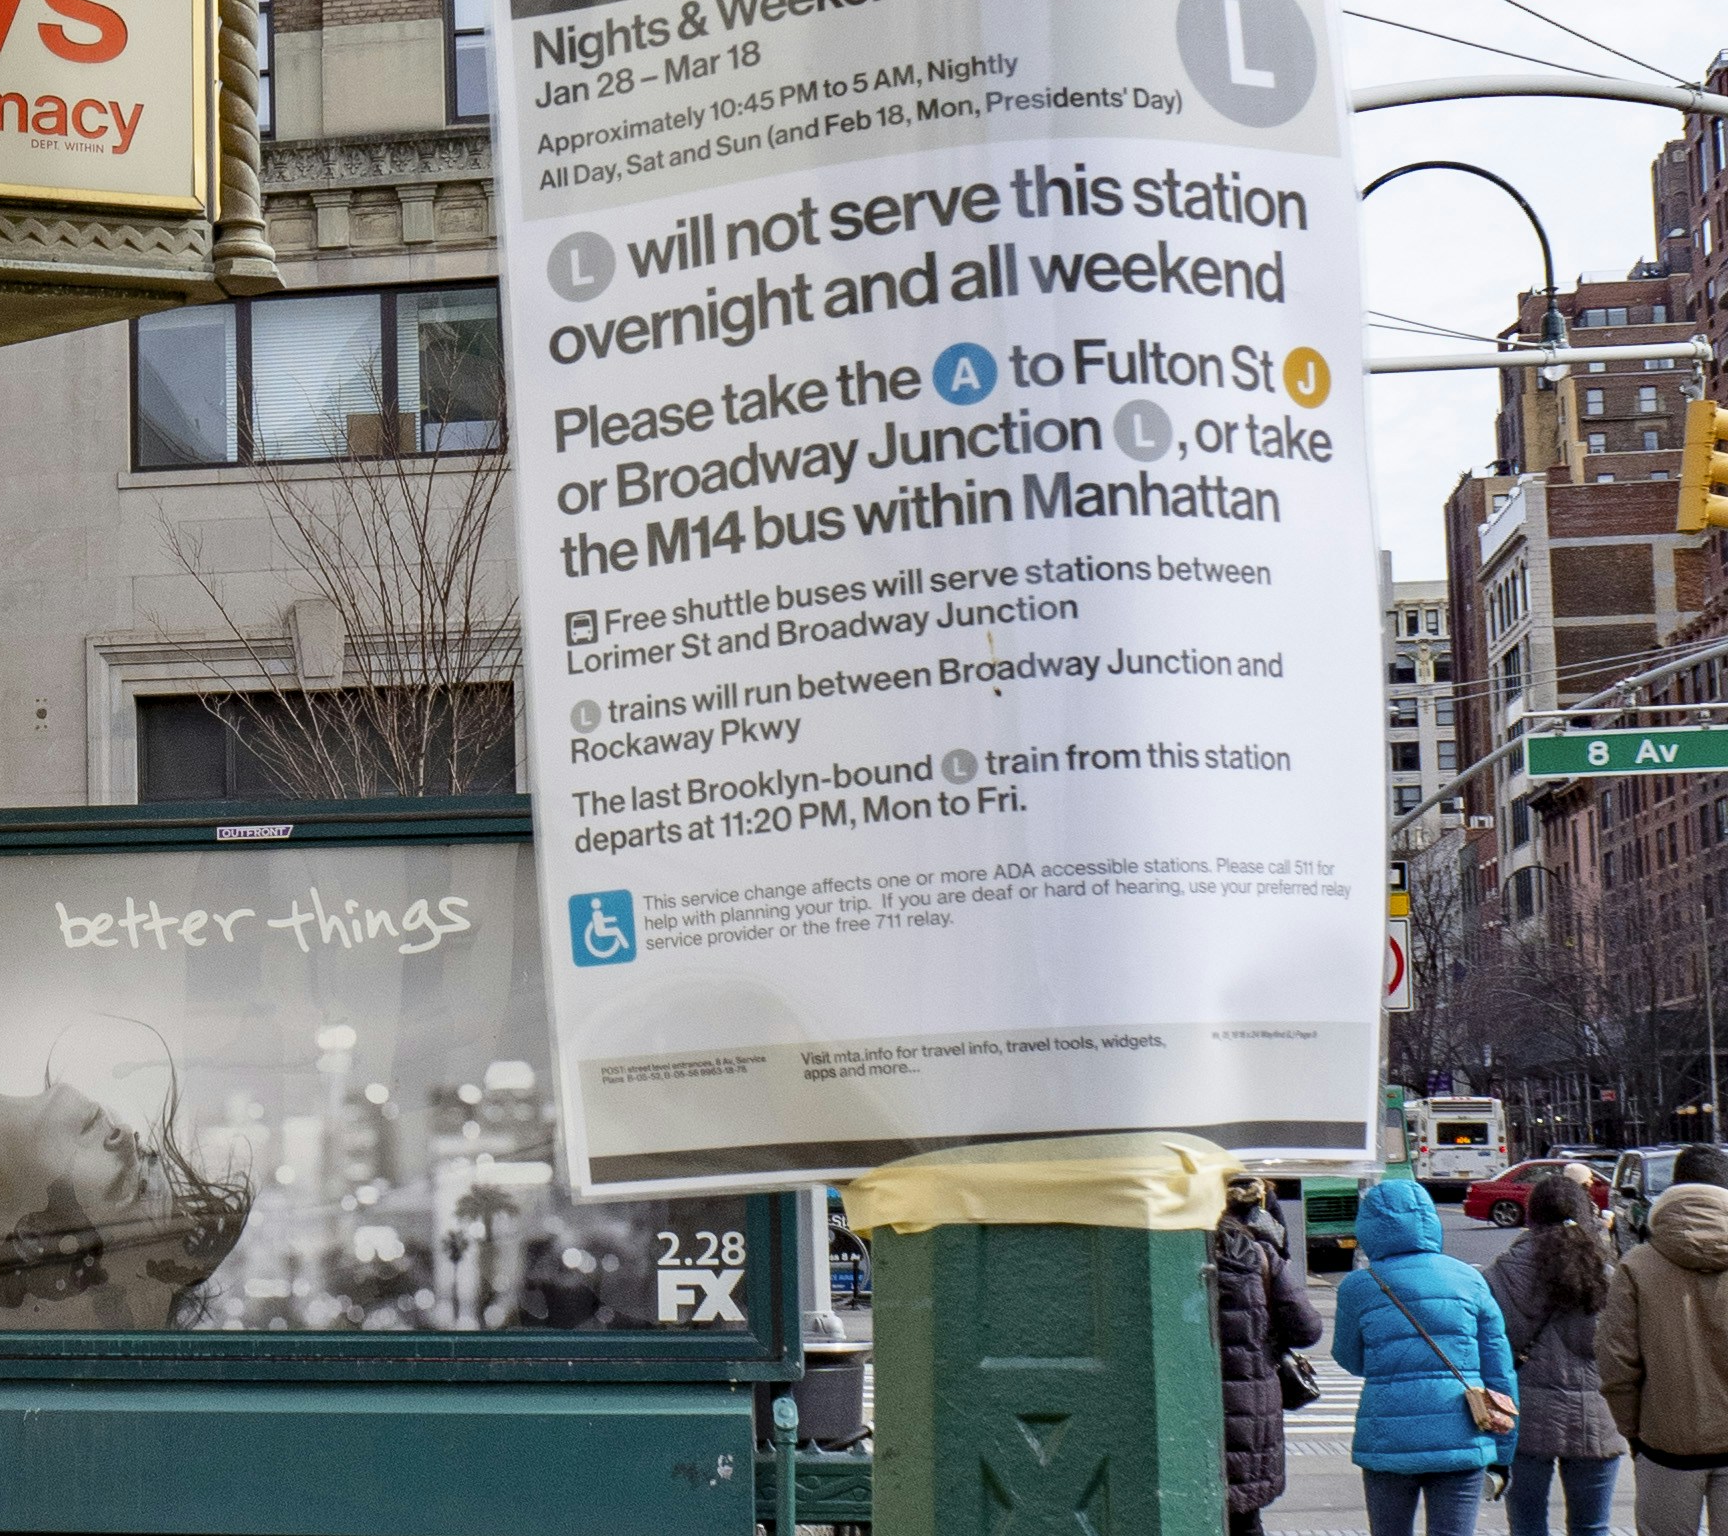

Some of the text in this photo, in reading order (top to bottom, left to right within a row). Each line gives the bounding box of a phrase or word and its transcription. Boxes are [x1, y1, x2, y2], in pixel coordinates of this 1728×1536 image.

[533, 14, 671, 70] Nights
[677, 0, 709, 41] &
[535, 40, 761, 109] Jan 28 Mar 18
[537, 53, 1018, 156] Approximately 10:45 PM to 5 AM, Nightly
[64, 141, 104, 154] WITHIN
[539, 86, 1183, 190] All Day, Sat and Sun (and Feb 18, Mon, Presidents' Day)
[569, 162, 1308, 287] L will not serve this station
[549, 240, 1285, 365] overnight and all weekend
[554, 338, 1317, 453] Please take the A to Fulton St J
[557, 478, 608, 515] or
[616, 438, 859, 508] Broadway
[867, 408, 1103, 469] Junction
[1195, 419, 1239, 454] or
[1245, 413, 1333, 463] take
[560, 470, 1280, 575] the M14 bus within Manhattan
[605, 555, 1271, 635] Free shuttle buses will serve stations between
[567, 595, 1079, 675] Lorimer St and Broadway Junction
[580, 648, 1283, 725] L trains will run between Broadway Junction and
[571, 717, 801, 764] Rockaway Pkwy
[1587, 739, 1679, 765] 8 Av
[572, 742, 1291, 817] The last Brooklyn-bound L train from this station
[222, 828, 287, 838] OUTFRONT
[575, 785, 1027, 855] departs at 11:20 PM, Mon to Fri.
[643, 857, 1335, 910] This service change affects one or more ADA accessible stations. Please call 511 for
[56, 887, 472, 955] better things
[800, 1034, 1166, 1065] Visit mta.info for travel info, travel tools, widgets,
[804, 1062, 921, 1083] apps and more...
[657, 1231, 745, 1268] 2.28
[658, 1269, 744, 1322] FX
